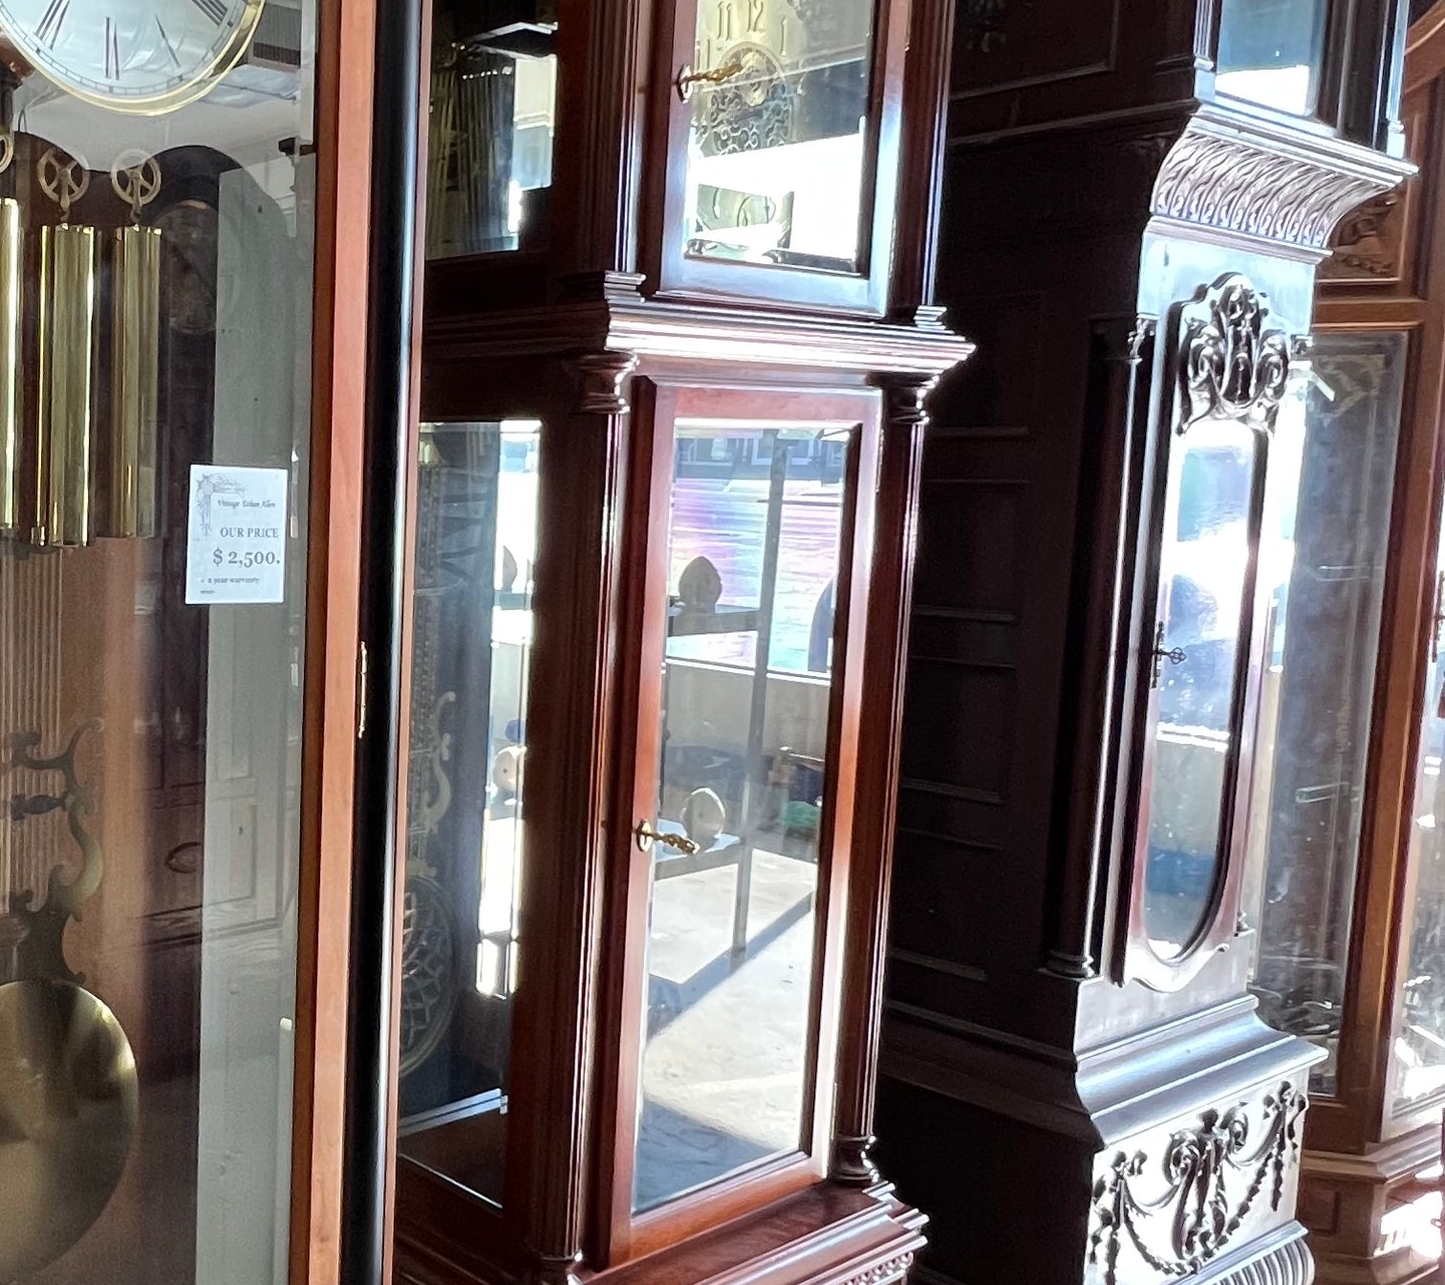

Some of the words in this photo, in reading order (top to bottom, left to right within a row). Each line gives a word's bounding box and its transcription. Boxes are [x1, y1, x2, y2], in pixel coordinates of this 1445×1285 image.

[716, 0, 733, 41] 11
[220, 526, 244, 538] OUR
[247, 527, 279, 539] PRICE
[228, 551, 280, 568] 2,500.
